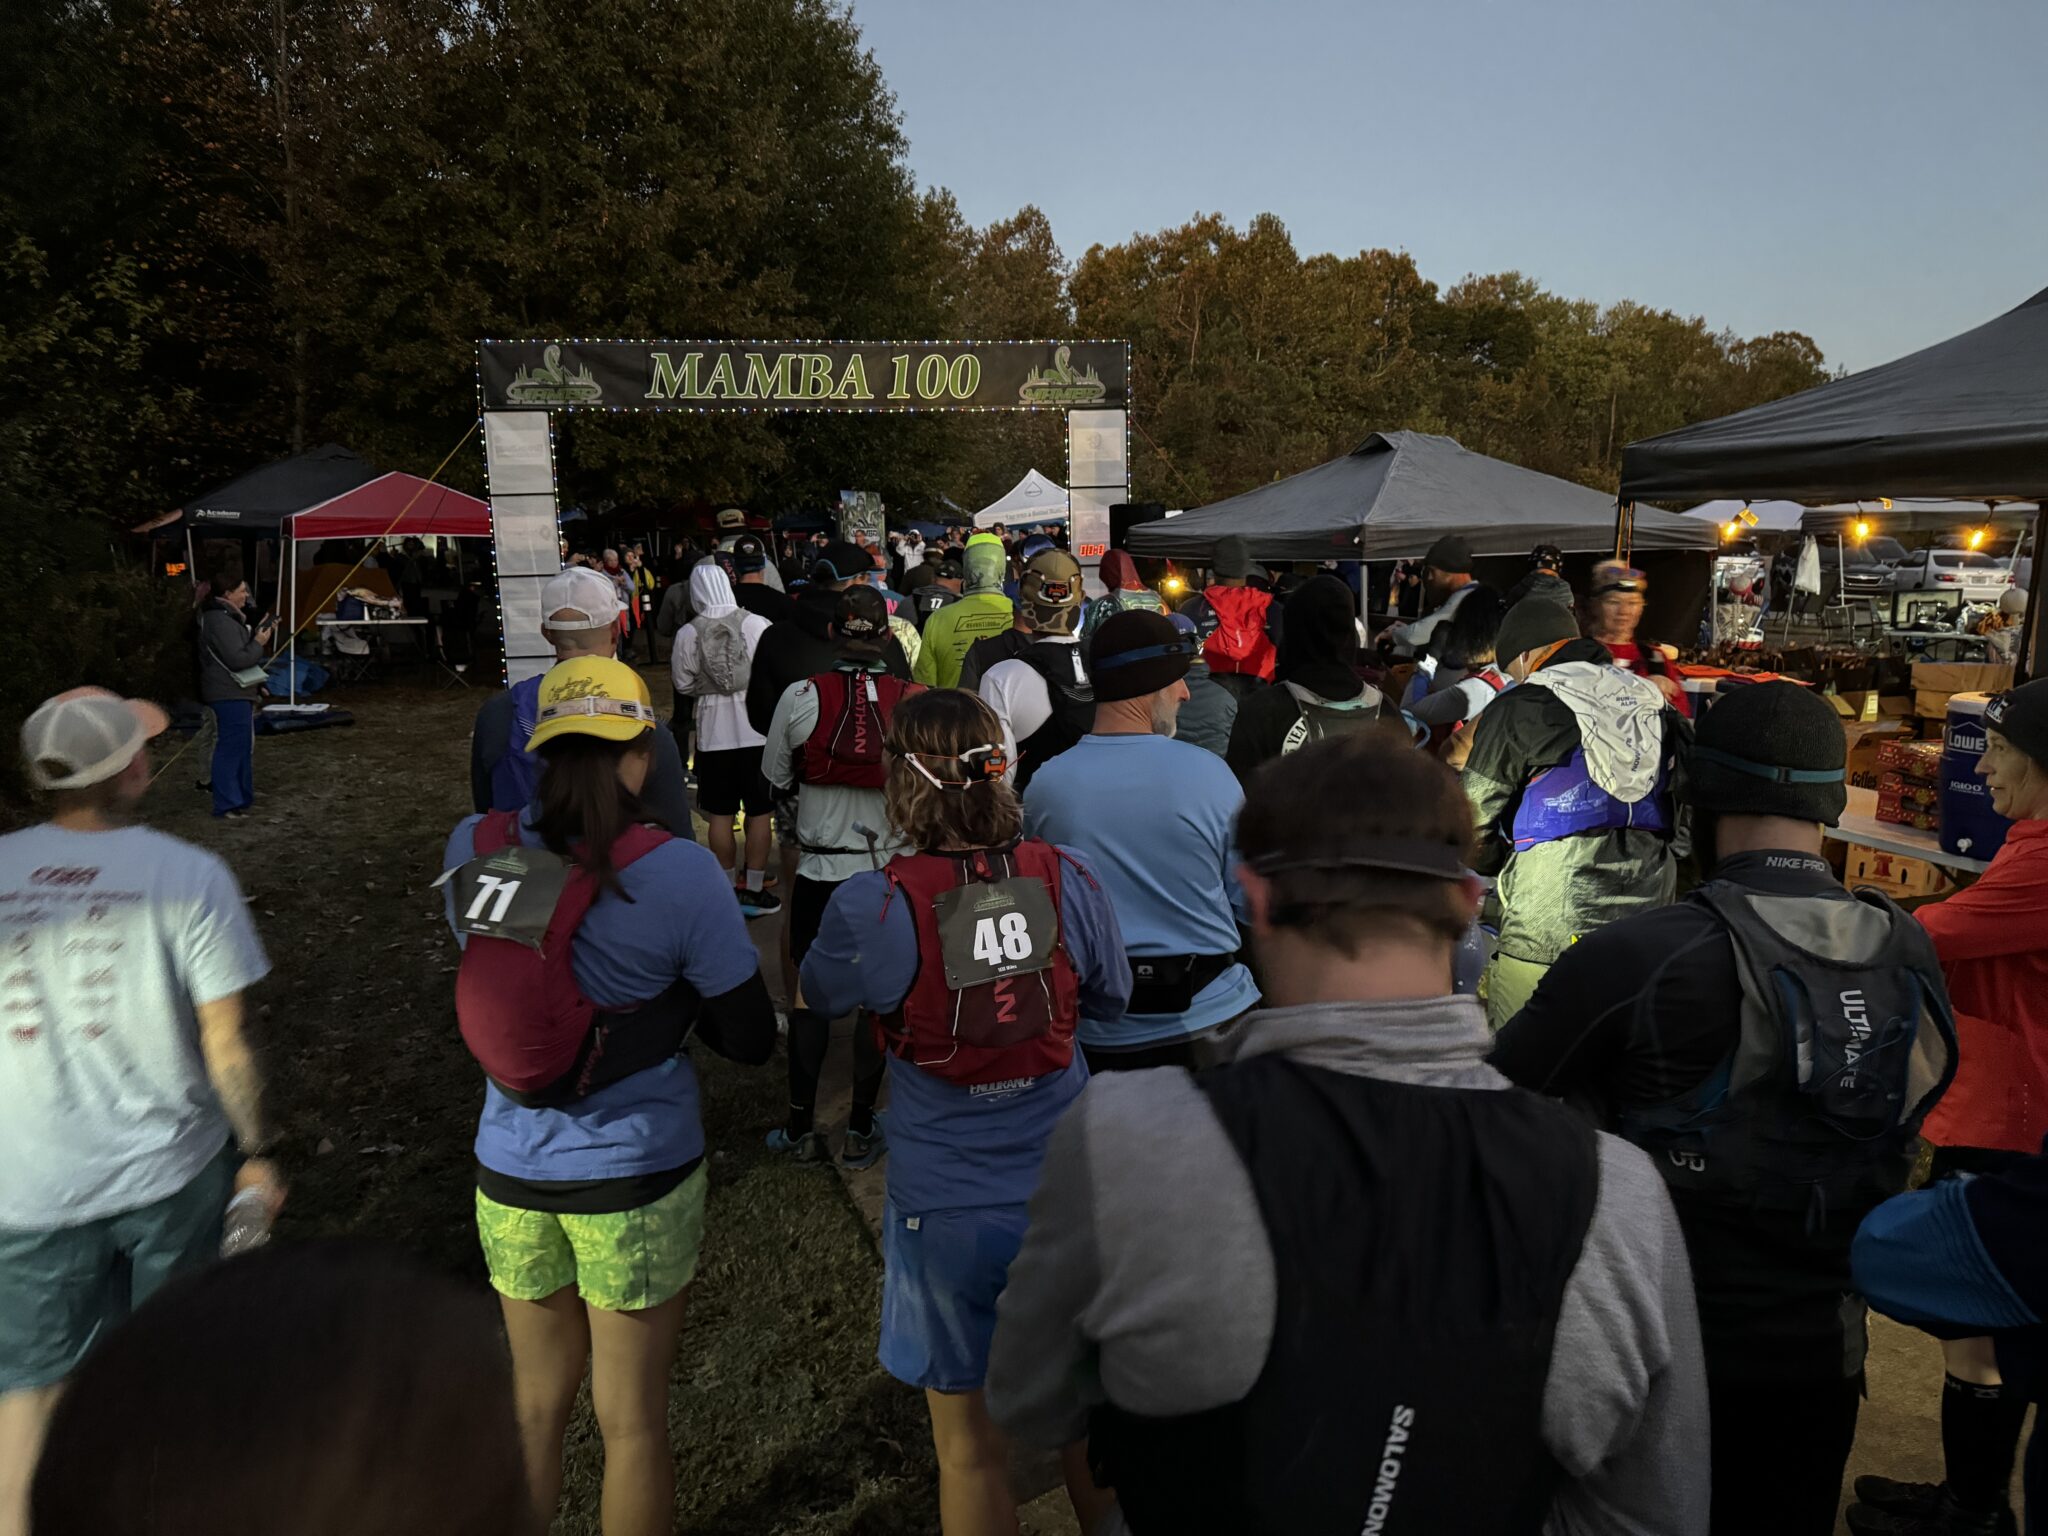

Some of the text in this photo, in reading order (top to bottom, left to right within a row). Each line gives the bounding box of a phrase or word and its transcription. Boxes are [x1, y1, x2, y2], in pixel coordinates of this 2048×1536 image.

[644, 353, 982, 400] MAMBA 100
[206, 509, 241, 517] Academy
[1079, 543, 1105, 557] 00:0
[930, 598, 944, 609] 17
[854, 682, 867, 754] NATHAN
[1765, 856, 1826, 872] NIKE PRO
[464, 874, 522, 922] 71
[973, 912, 1033, 966] 48
[1360, 1404, 1416, 1536] SALOMON
